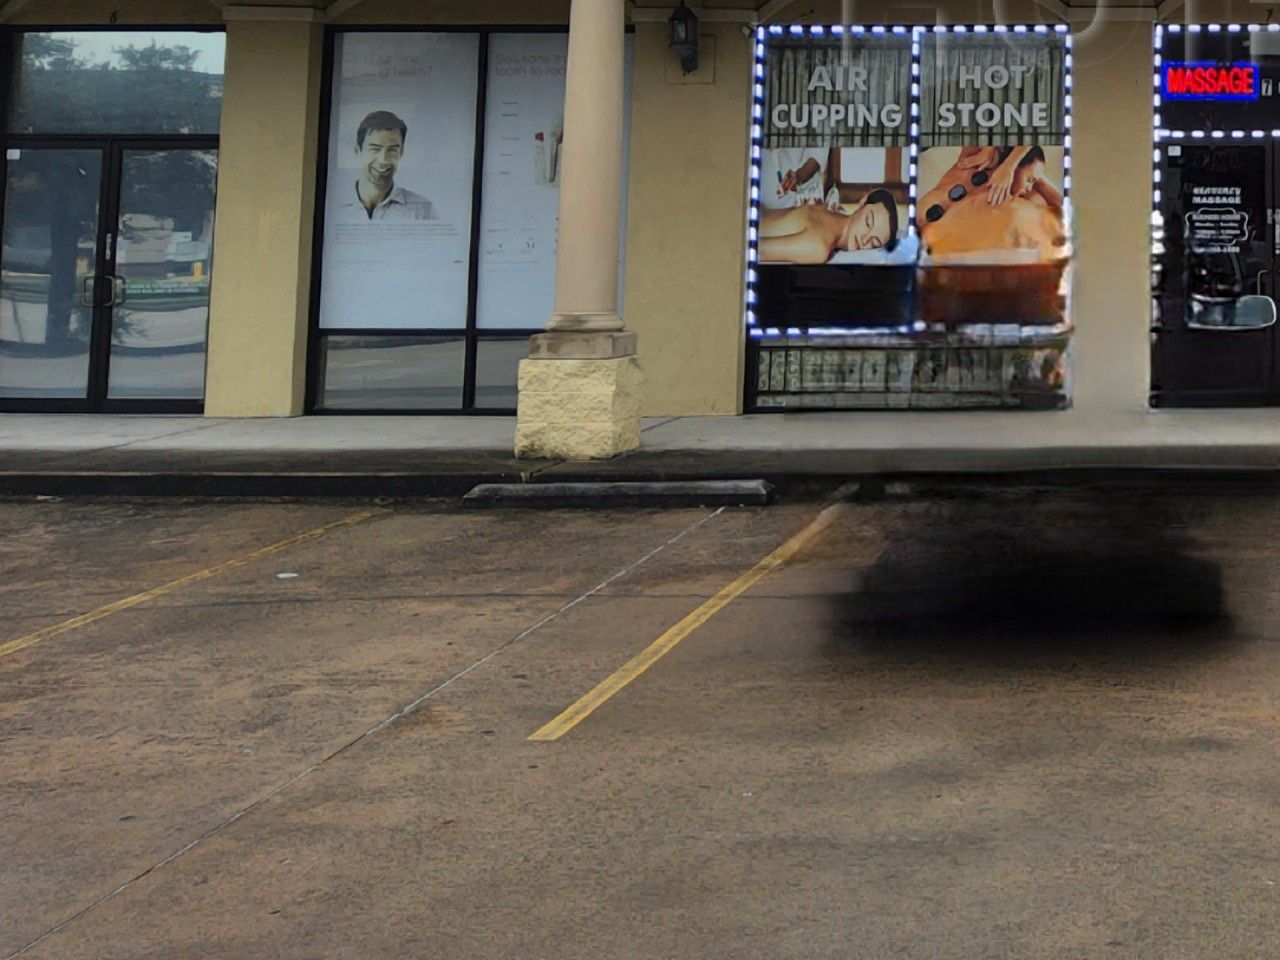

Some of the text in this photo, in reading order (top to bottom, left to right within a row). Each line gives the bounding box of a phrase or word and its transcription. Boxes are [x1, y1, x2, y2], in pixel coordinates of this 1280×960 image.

[807, 65, 869, 91] AIR
[959, 65, 1030, 89] HOT
[1166, 67, 1254, 94] MASSAGE
[771, 103, 902, 128] CUPPING
[938, 102, 1048, 127] STONE
